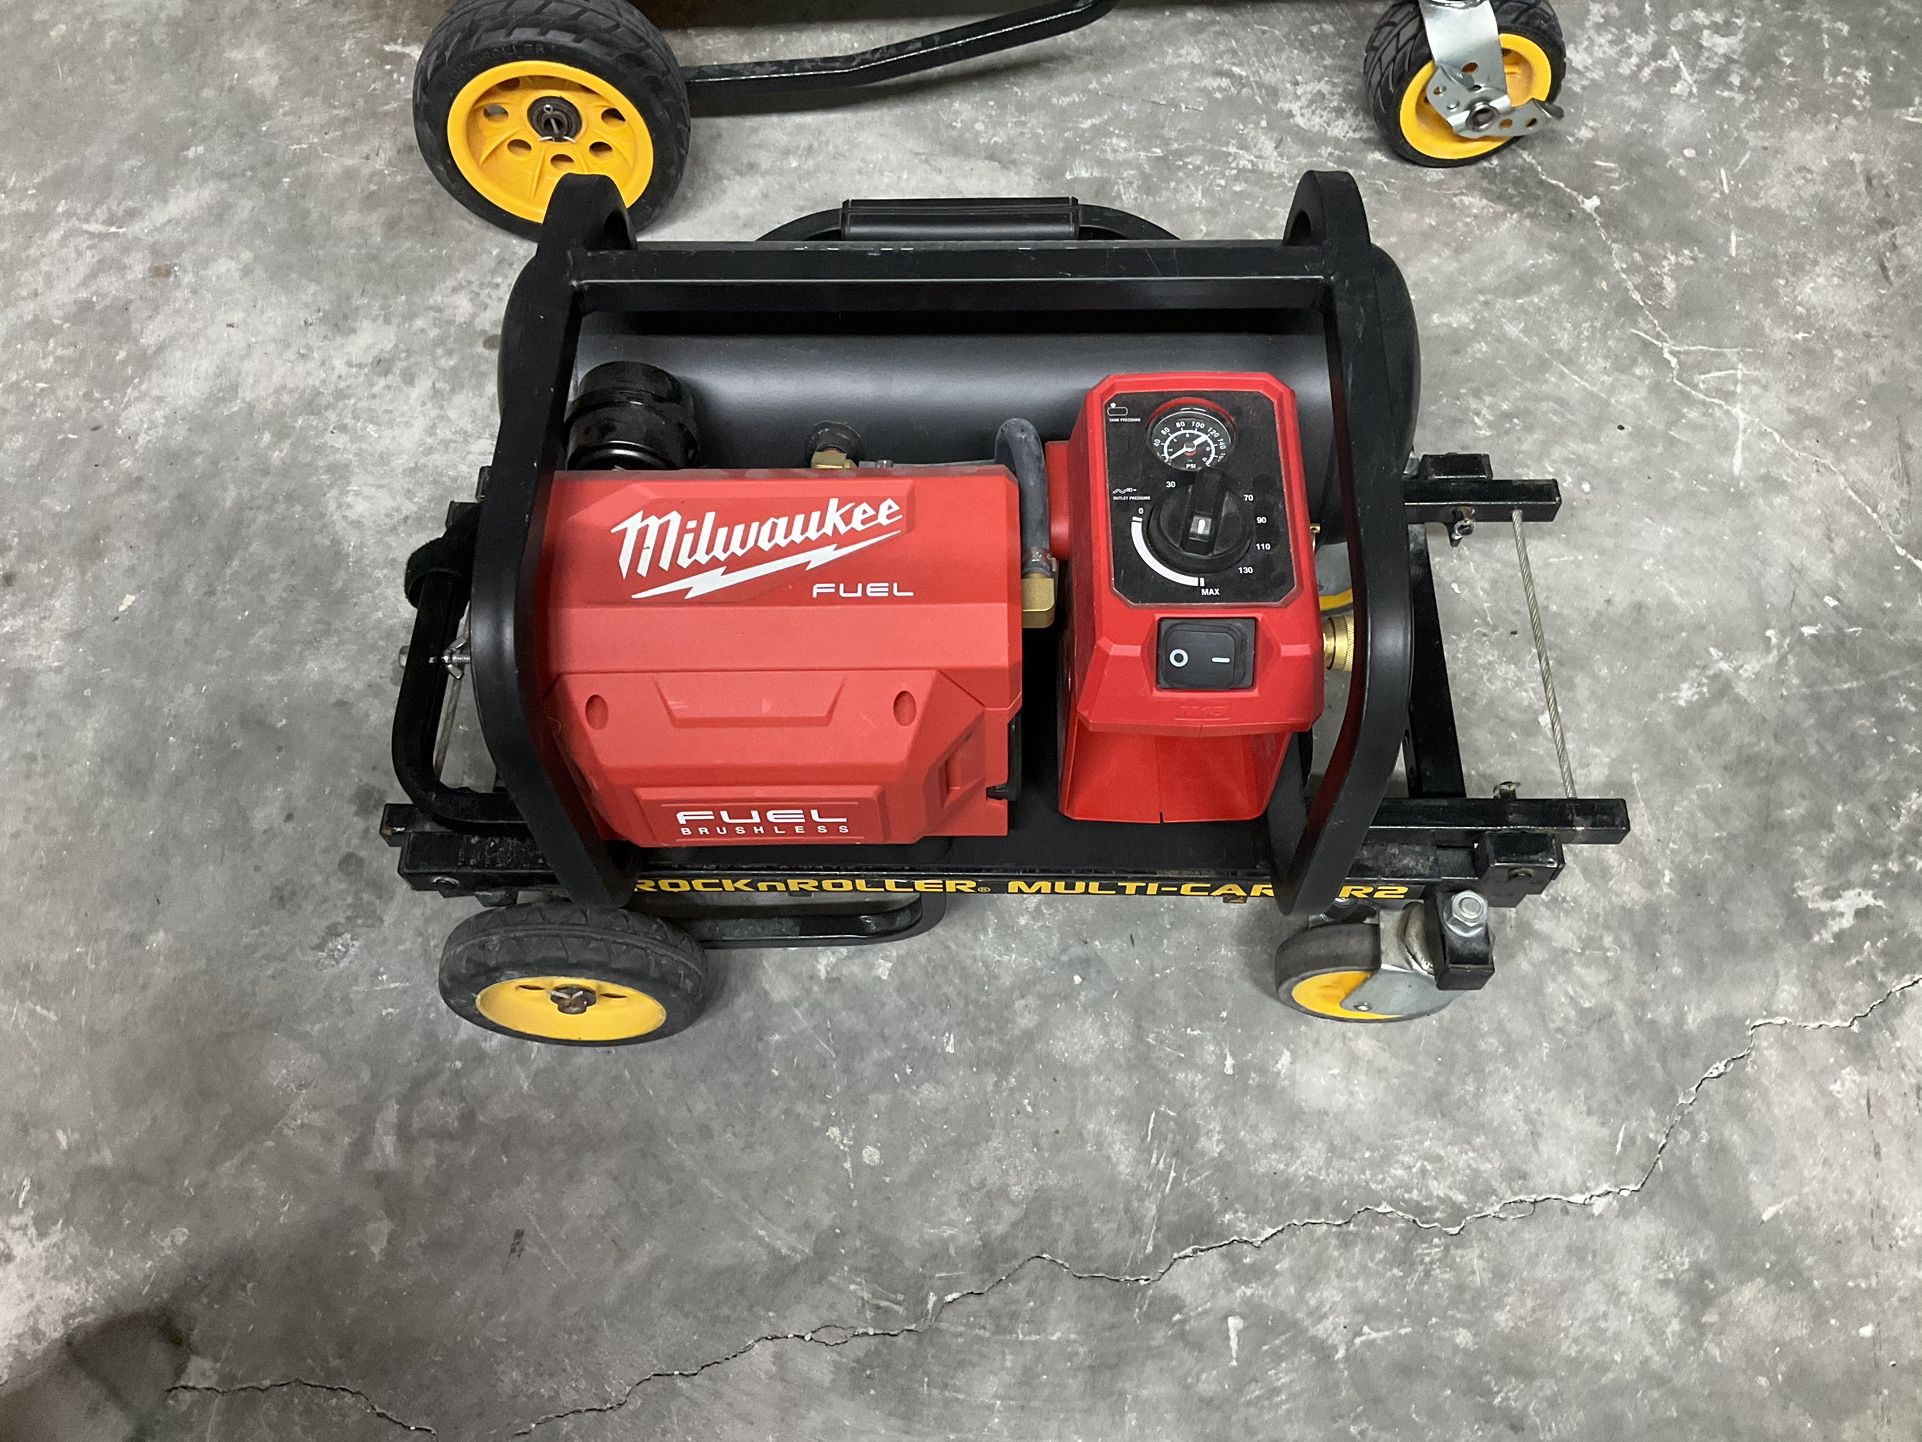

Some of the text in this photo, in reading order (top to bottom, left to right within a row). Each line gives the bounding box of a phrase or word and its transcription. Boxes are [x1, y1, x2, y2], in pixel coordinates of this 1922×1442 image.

[1191, 421, 1205, 429] 100
[1207, 427, 1220, 438] 120
[610, 498, 903, 580] Milwaukee
[812, 582, 914, 598] FUEL
[1201, 588, 1220, 596] MAX
[676, 809, 848, 825] FUEL
[680, 825, 849, 836] BRUSHLESS
[1338, 885, 1409, 899] R2
